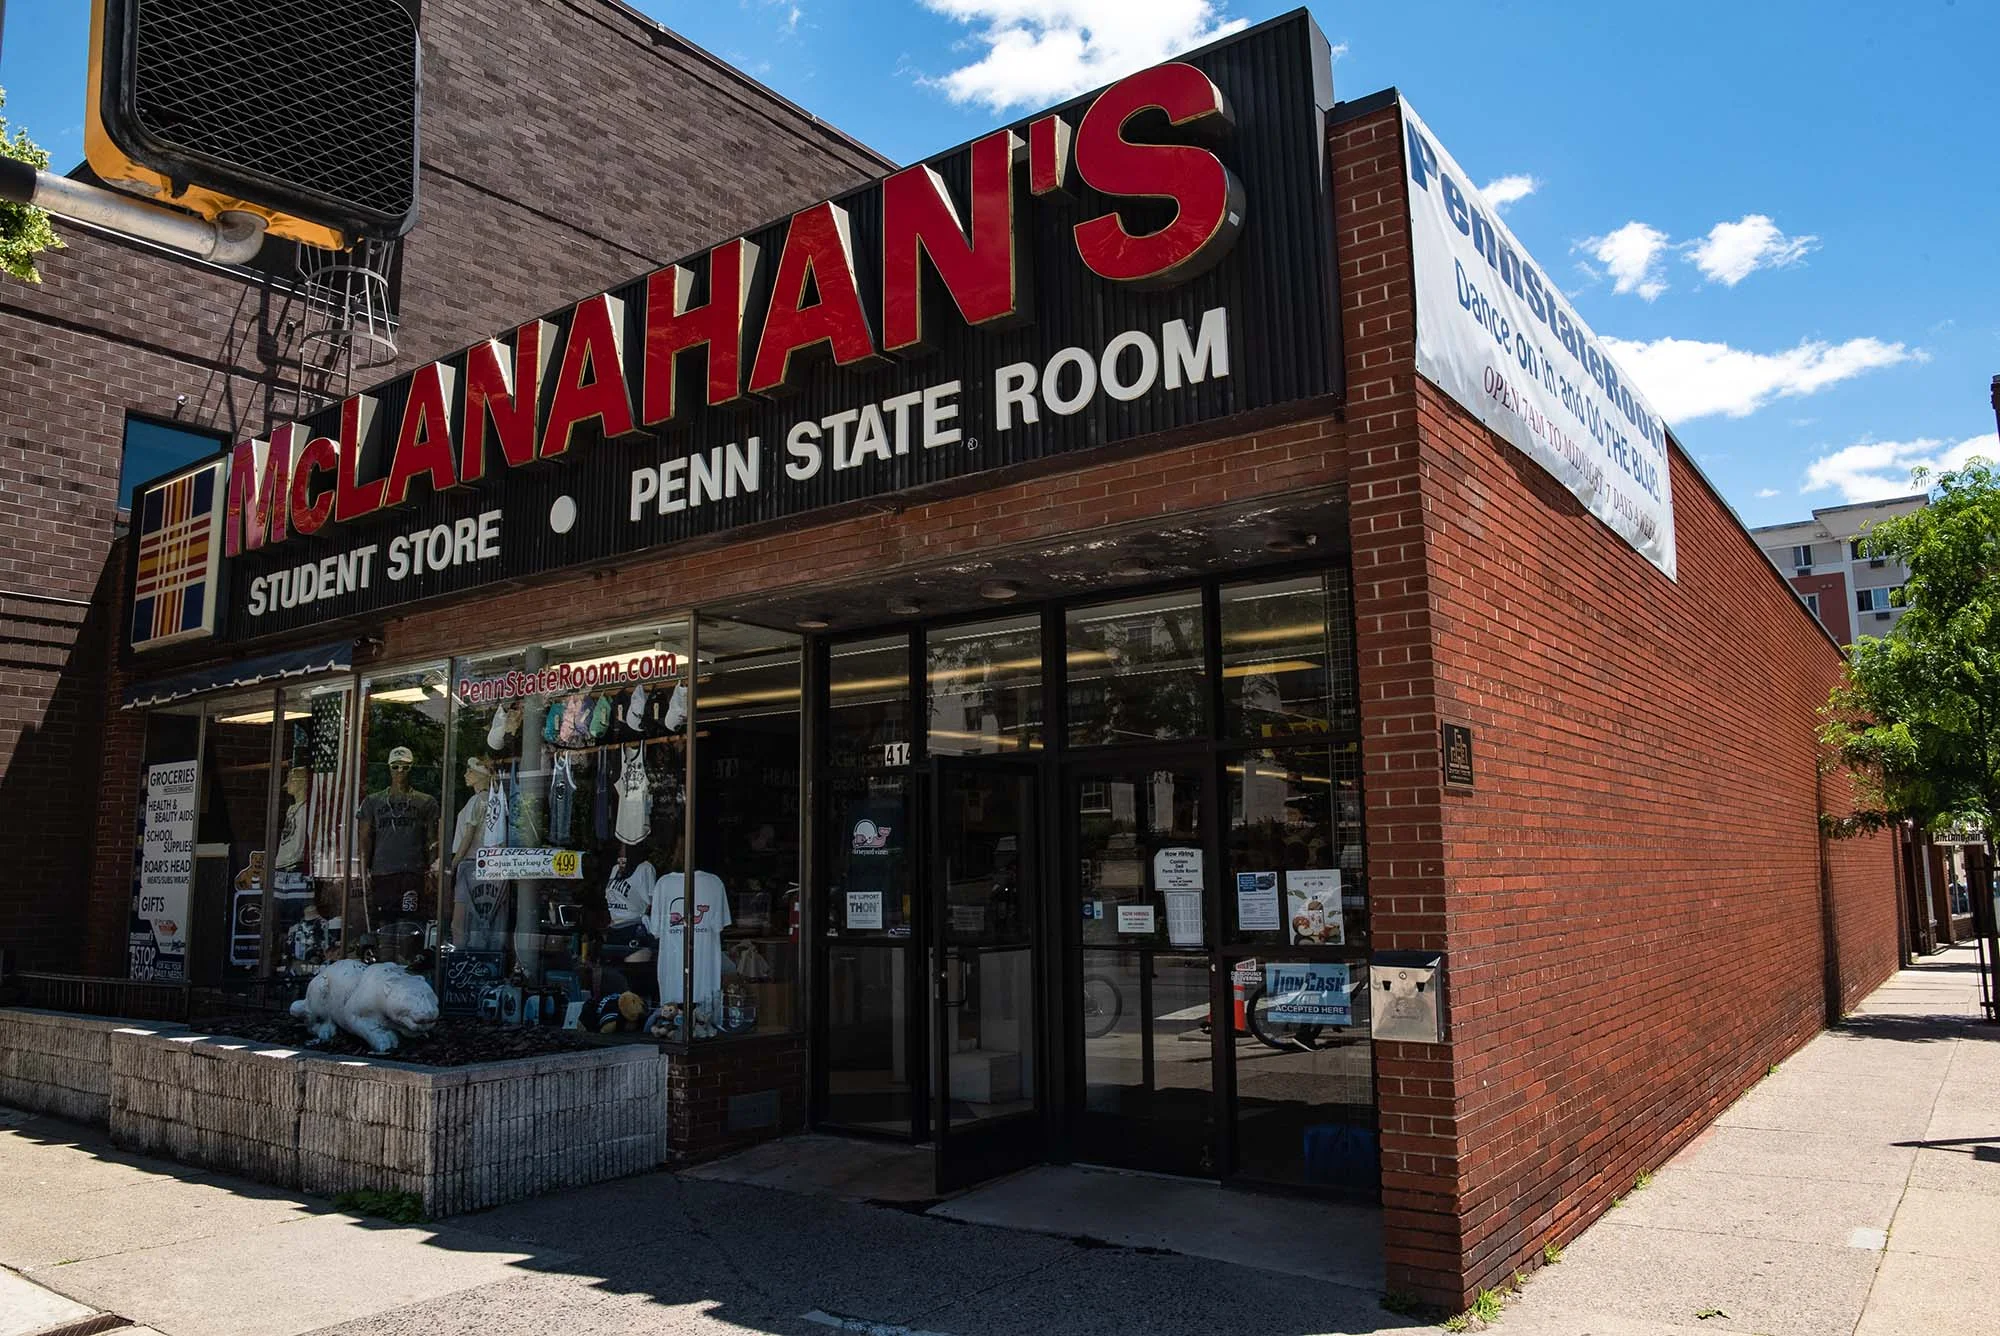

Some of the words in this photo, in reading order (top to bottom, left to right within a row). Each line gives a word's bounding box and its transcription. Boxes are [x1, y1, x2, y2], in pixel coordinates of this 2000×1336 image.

[226, 62, 1238, 557] McLANAHAN'S
[1454, 256, 1512, 355] Dance
[1516, 332, 1538, 380] on
[1539, 346, 1557, 398] in
[1559, 375, 1585, 426] and
[1604, 418, 1631, 475] THE
[630, 436, 760, 522] PENN
[785, 380, 962, 481] STATE
[995, 306, 1230, 431] ROOM
[1484, 365, 1520, 416] OPEN
[1522, 398, 1546, 440] 7AM
[1546, 420, 1562, 452] TO
[1563, 434, 1604, 496] MIDNIGHT
[1605, 483, 1611, 503] 7
[1613, 487, 1633, 522] DAYS
[248, 543, 378, 616] STUDENT
[387, 508, 503, 581] STORE
[459, 653, 678, 703] PennStateRoom.com
[150, 768, 195, 787] GROCERIES
[148, 799, 172, 812] HEALTH
[154, 811, 178, 823] BEAUTY
[179, 810, 194, 821] AIDS
[146, 829, 174, 842] SCHOOL
[163, 840, 193, 853] SUPPLIES
[504, 848, 554, 857] SPECIAL
[1178, 850, 1195, 858] Hiring
[144, 860, 169, 873] BOAR'S
[170, 859, 192, 873] HEAD
[487, 859, 511, 868] Cajun
[512, 858, 541, 867] Turkey
[556, 854, 576, 872] 4.99
[141, 896, 165, 912] GIFTS
[135, 946, 157, 966] STOP
[133, 965, 155, 982] SHOP
[1275, 1004, 1320, 1014] ACCEPTED
[1321, 1005, 1345, 1015] HERE
